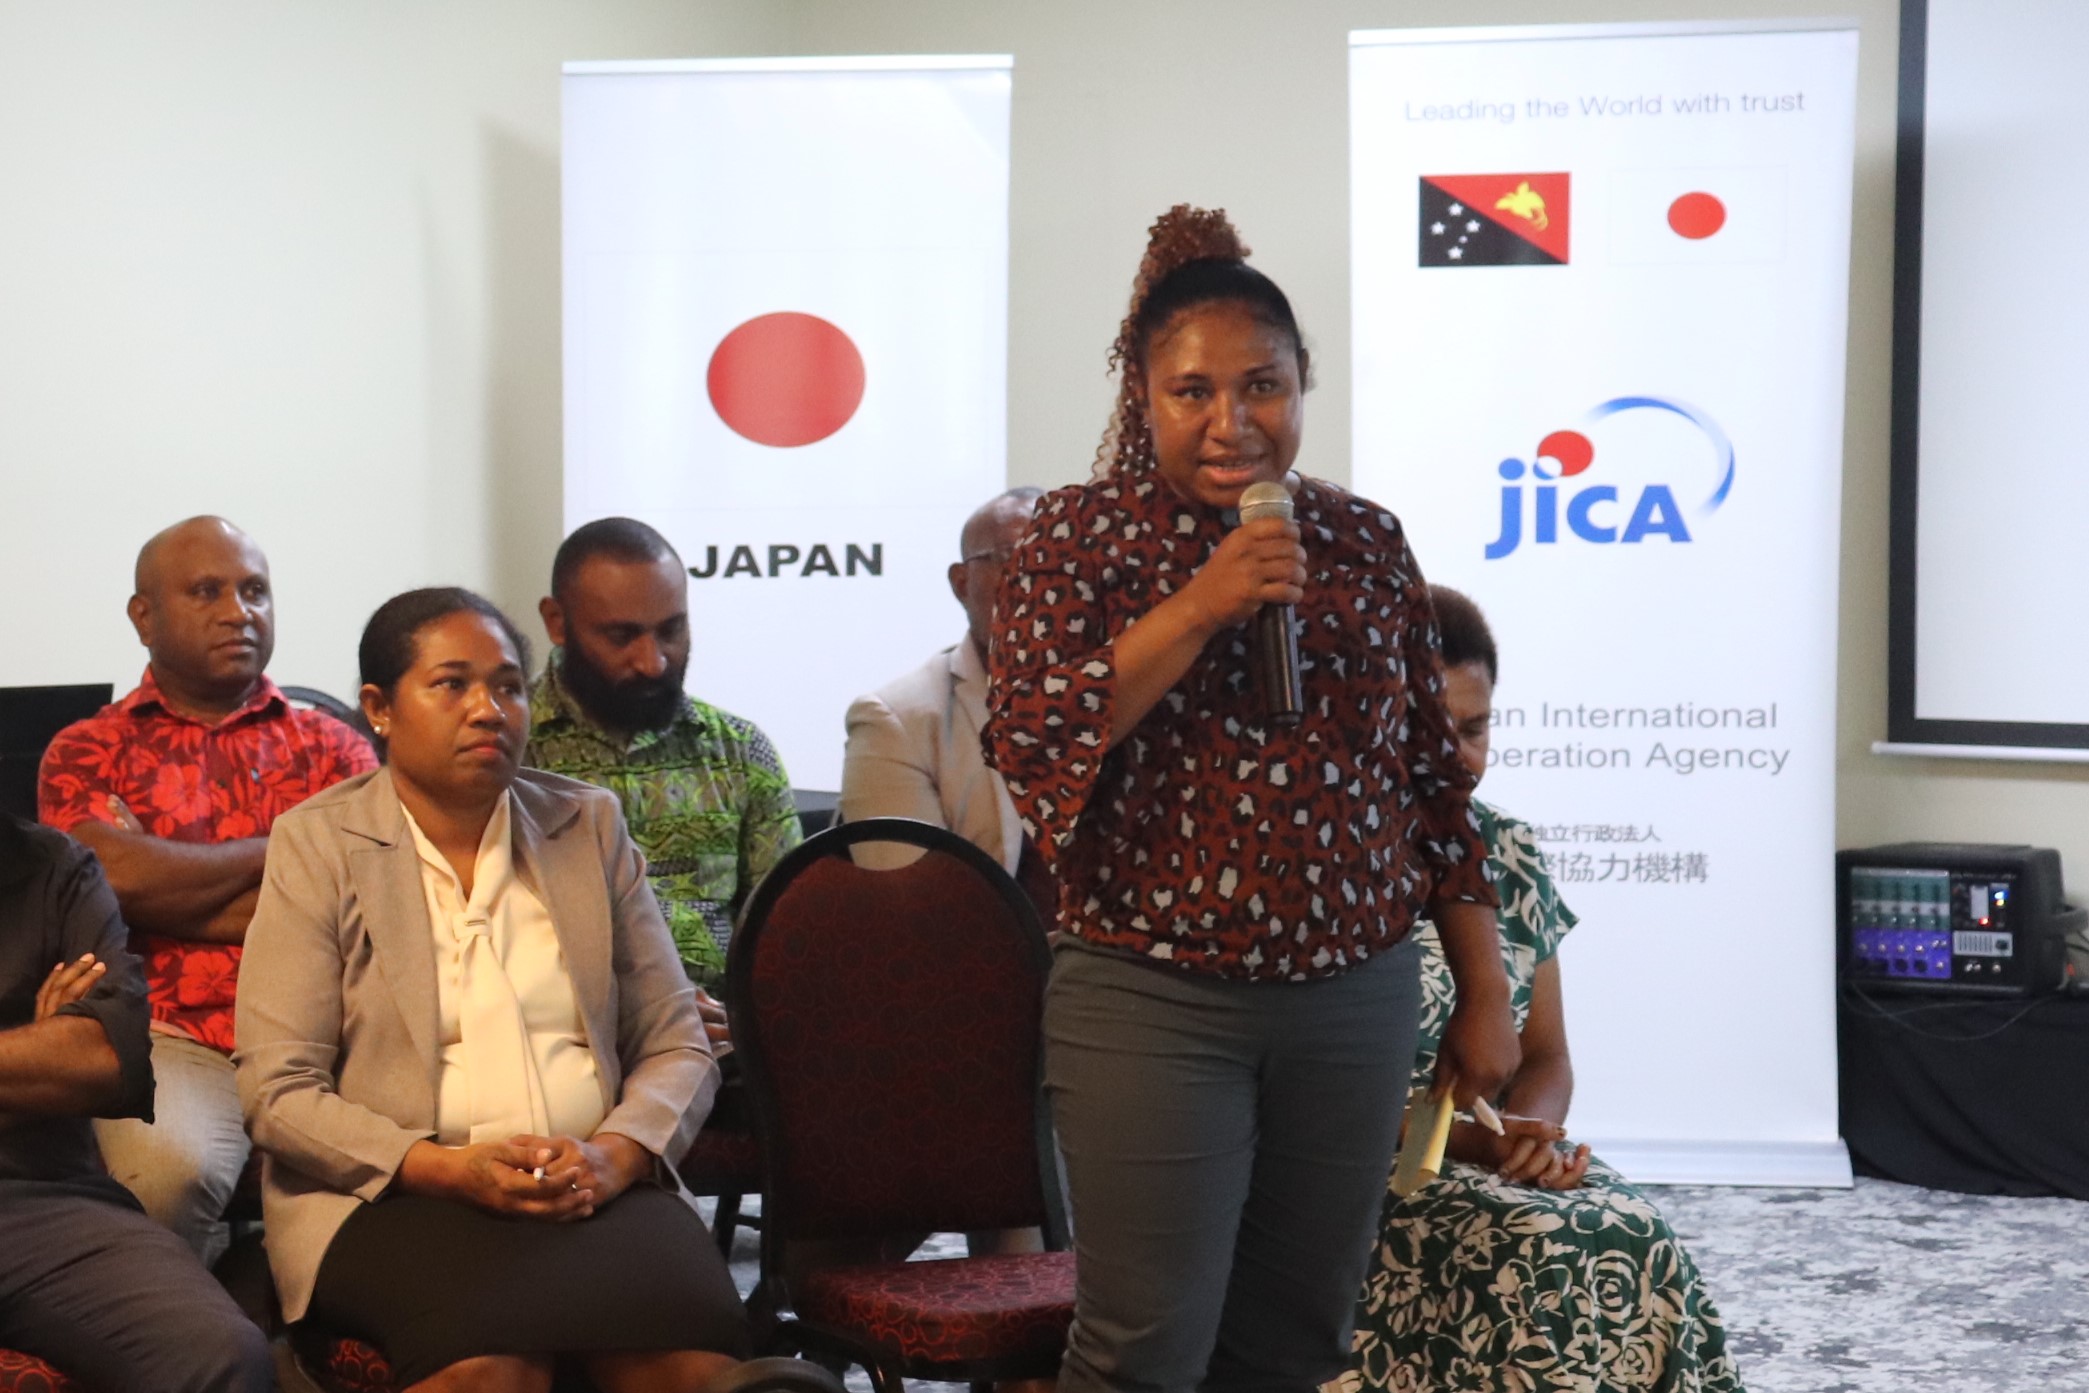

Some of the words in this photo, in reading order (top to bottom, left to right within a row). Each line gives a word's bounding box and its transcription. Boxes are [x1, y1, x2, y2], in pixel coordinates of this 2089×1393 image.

[1405, 99, 1516, 125] Leading
[1526, 98, 1570, 118] the
[1579, 94, 1663, 117] World
[1674, 92, 1731, 114] with
[1740, 90, 1806, 112] trust
[687, 542, 884, 579] JAPAN
[1542, 701, 1778, 730] International
[1645, 741, 1791, 777] Agency
